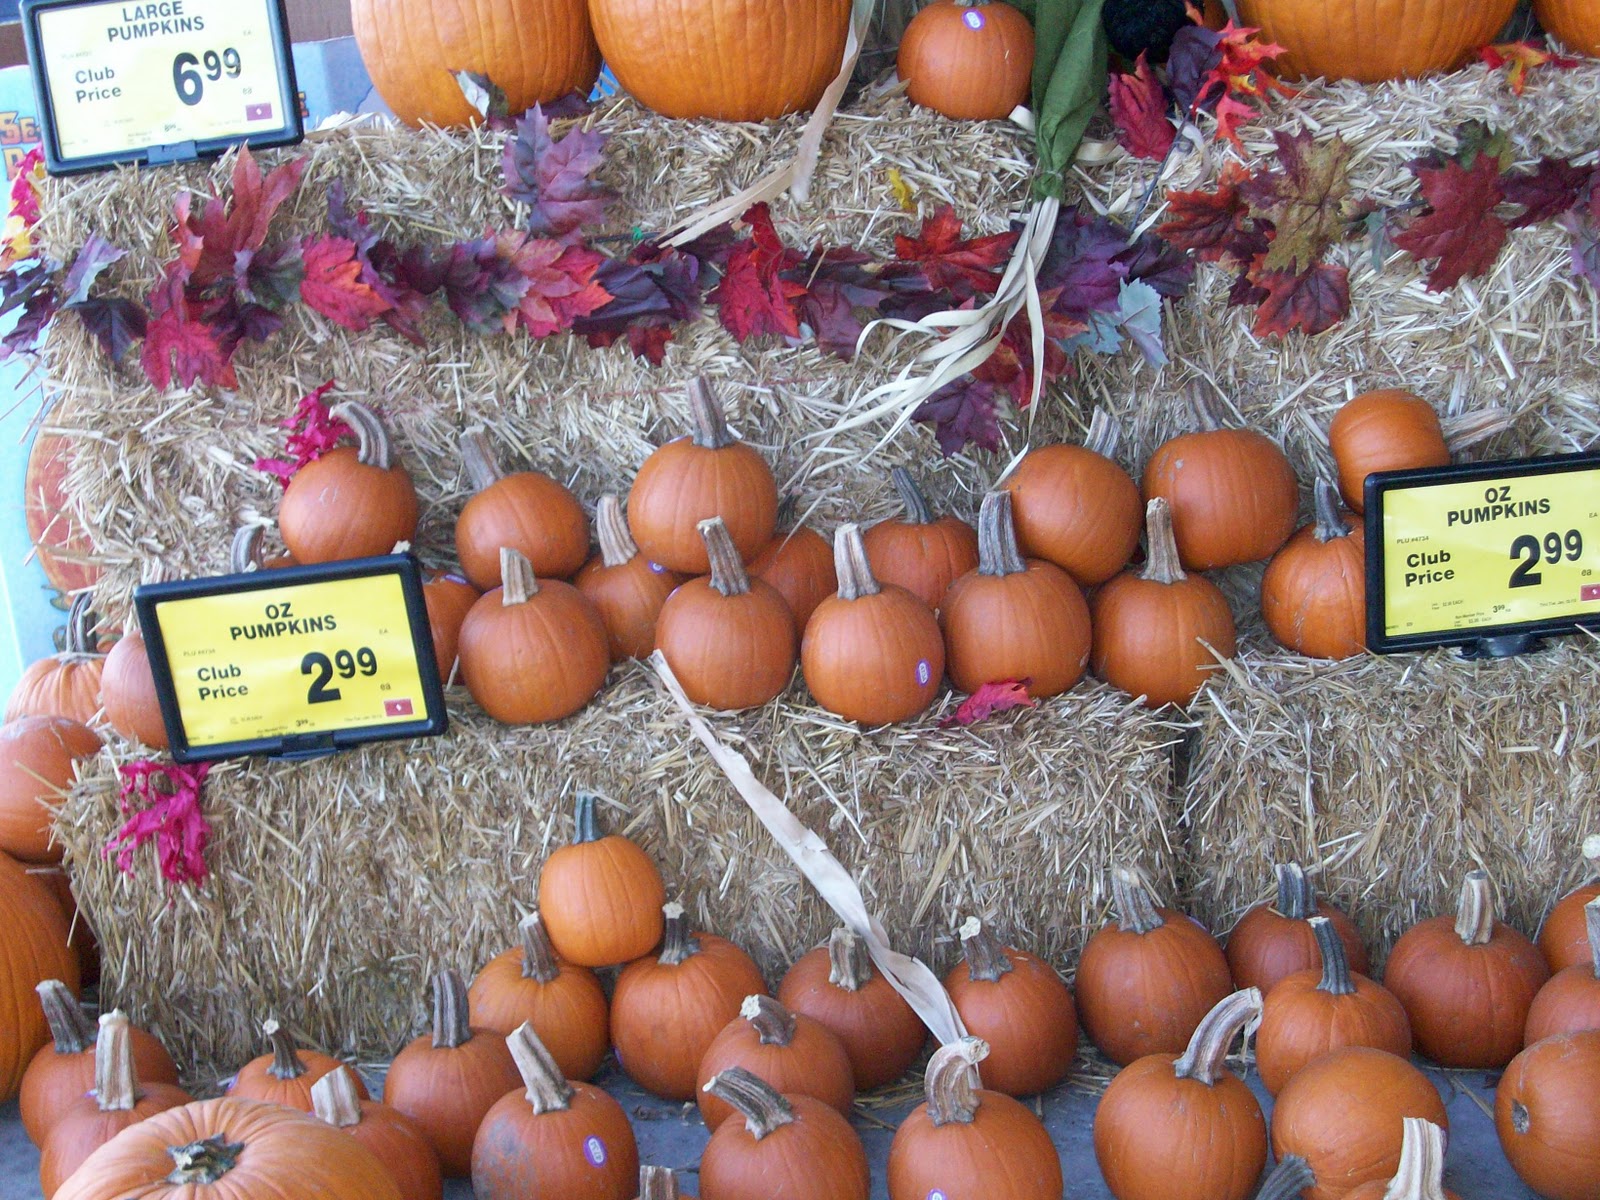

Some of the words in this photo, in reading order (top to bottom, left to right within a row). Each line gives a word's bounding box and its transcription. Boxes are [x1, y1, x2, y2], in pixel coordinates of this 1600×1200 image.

[122, 1, 184, 22] LARGE
[107, 16, 205, 42] PUMPKINS
[75, 66, 115, 84] Club
[76, 86, 122, 103] Price
[1484, 486, 1511, 503] OZ
[1447, 498, 1551, 527] PUMPKINS
[1406, 550, 1451, 568] Club
[1405, 568, 1455, 587] Price
[1581, 568, 1592, 577] ea
[265, 602, 293, 620] OZ
[230, 614, 337, 641] PUMPKINS
[197, 664, 241, 682] Club
[198, 685, 249, 701] Price
[380, 682, 391, 691] ea
